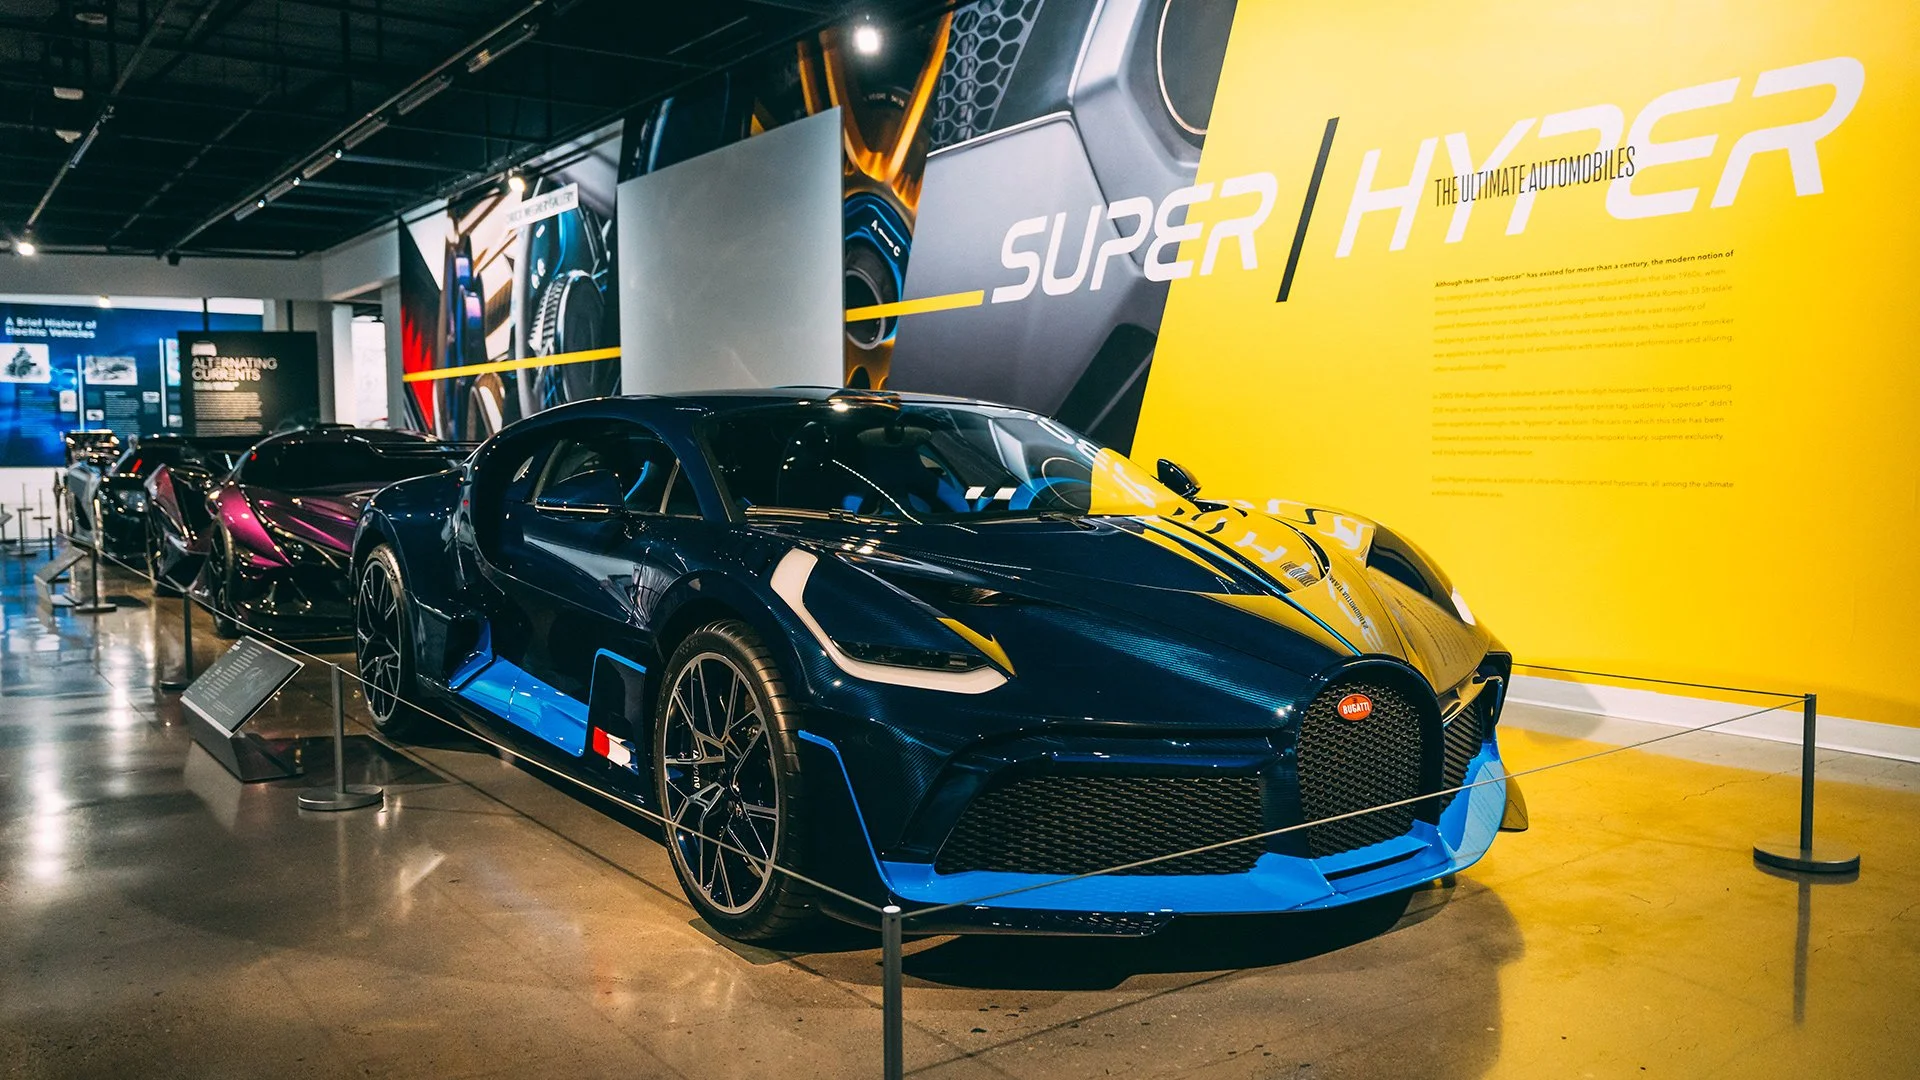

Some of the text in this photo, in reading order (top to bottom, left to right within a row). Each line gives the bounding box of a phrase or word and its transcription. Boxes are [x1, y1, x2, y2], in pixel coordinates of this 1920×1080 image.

[991, 172, 1278, 303] SUPER
[1334, 57, 1866, 258] HYPER
[1435, 146, 1635, 207] THE ULTIMATE AUTOMOBILES
[871, 219, 901, 257] A C
[1539, 268, 1563, 277] existed
[1596, 263, 1612, 271] than
[1620, 260, 1649, 268] century,
[1651, 257, 1664, 265] the
[1665, 255, 1696, 264] modern
[1697, 251, 1723, 260] notion
[1725, 249, 1734, 257] of
[1701, 283, 1733, 293] Stradale
[1697, 302, 1706, 310] of
[5, 316, 97, 330] A Brief History of
[1666, 321, 1700, 330] supercar
[1701, 317, 1734, 326] moniker
[5, 326, 96, 339] Electric Vehicles
[1686, 336, 1702, 344] and
[192, 357, 278, 370] ALTERNATING
[192, 367, 261, 381] CURRENTS
[1667, 384, 1690, 394] speed
[1691, 382, 1732, 393] surpassing
[1688, 416, 1703, 424] has
[1704, 415, 1726, 423] been
[1662, 481, 1688, 489] among
[1689, 479, 1702, 487] the
[1702, 479, 1734, 487] ultimate
[1342, 702, 1370, 715] BUGATTI
